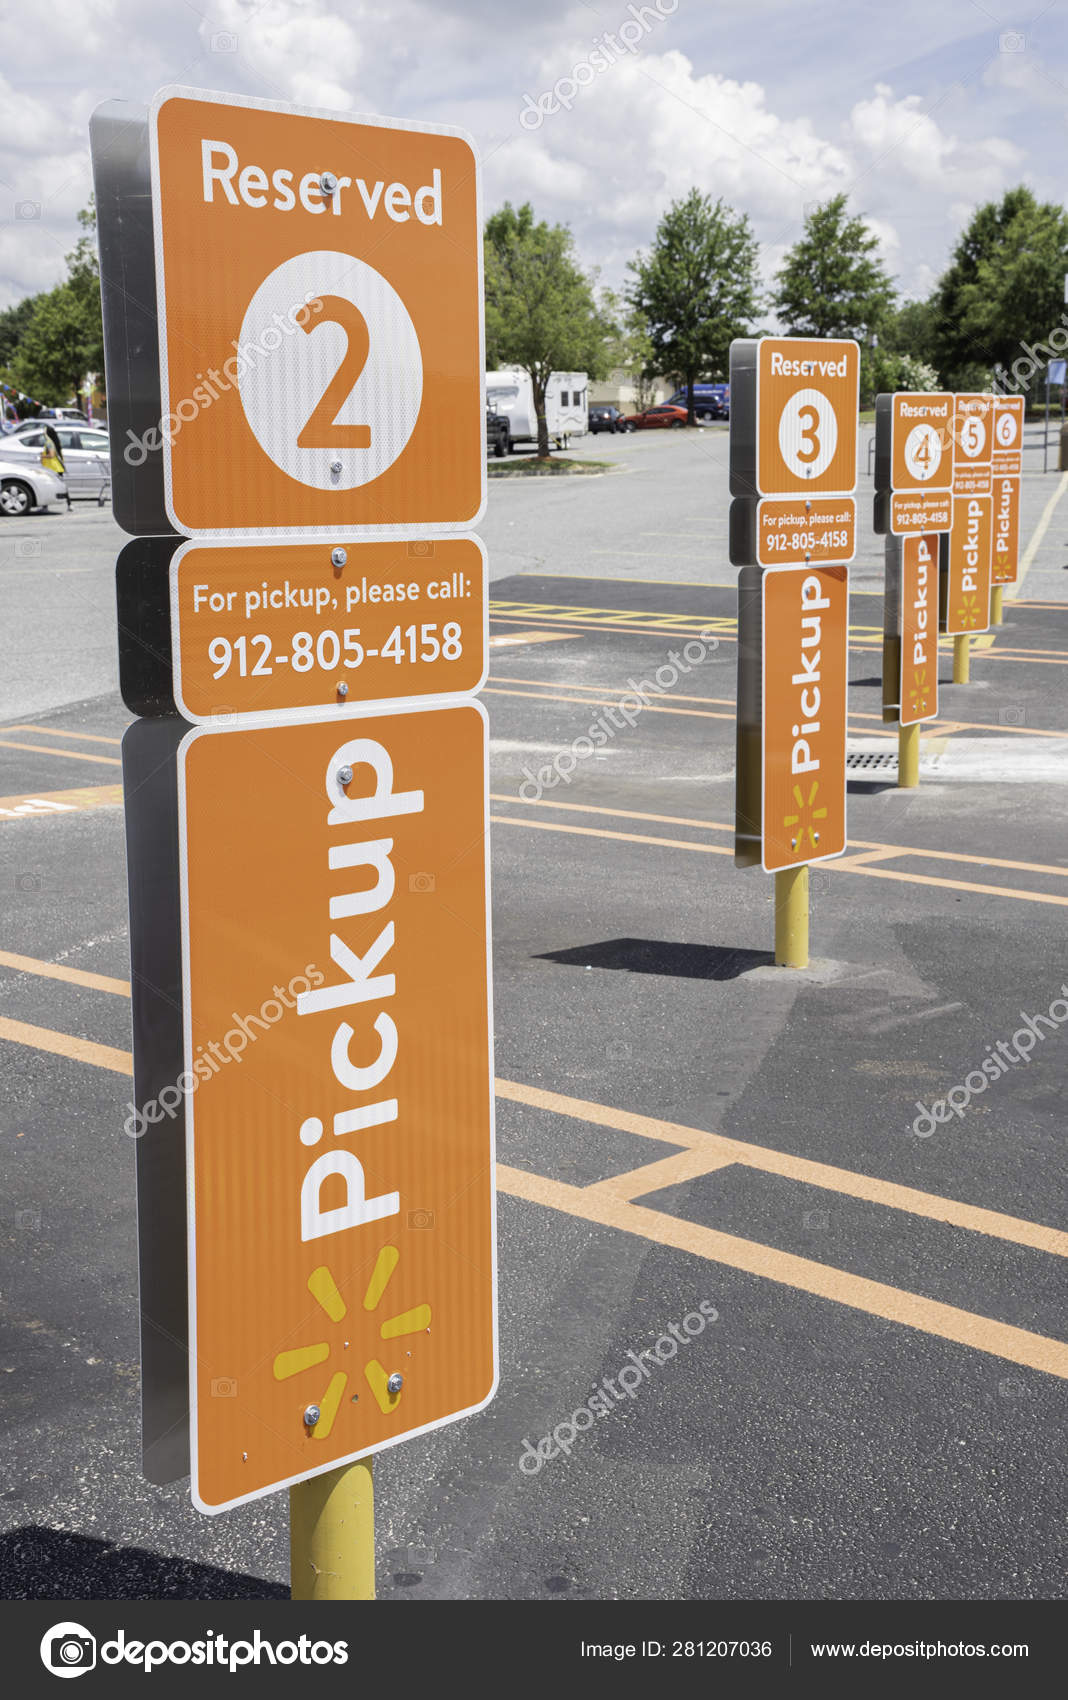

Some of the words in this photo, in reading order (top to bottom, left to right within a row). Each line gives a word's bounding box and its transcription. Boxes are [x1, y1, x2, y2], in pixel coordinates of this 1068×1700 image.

[201, 139, 443, 227] Reserved
[297, 295, 371, 449] 2
[770, 352, 848, 378] Reserved
[796, 404, 821, 463] 3
[900, 402, 948, 417] Reserved
[1002, 418, 1010, 440] 6
[914, 433, 931, 470] 4
[968, 423, 979, 450] 5
[763, 514, 777, 526] For
[778, 513, 808, 528] pickup,
[809, 512, 834, 527] please
[835, 512, 851, 523] call:
[766, 530, 848, 551] 912-805-4158
[896, 511, 948, 525] 912-805-4158
[996, 480, 1014, 552] Pickup
[962, 501, 983, 592] Pickup
[193, 585, 237, 612] For
[245, 581, 338, 619] pickup,
[346, 577, 420, 613] please
[426, 572, 471, 599] call:
[914, 540, 932, 665] Pickup
[208, 621, 462, 680] 912-805-4158
[791, 575, 830, 775] Pickup
[297, 737, 424, 1242] Pickup
